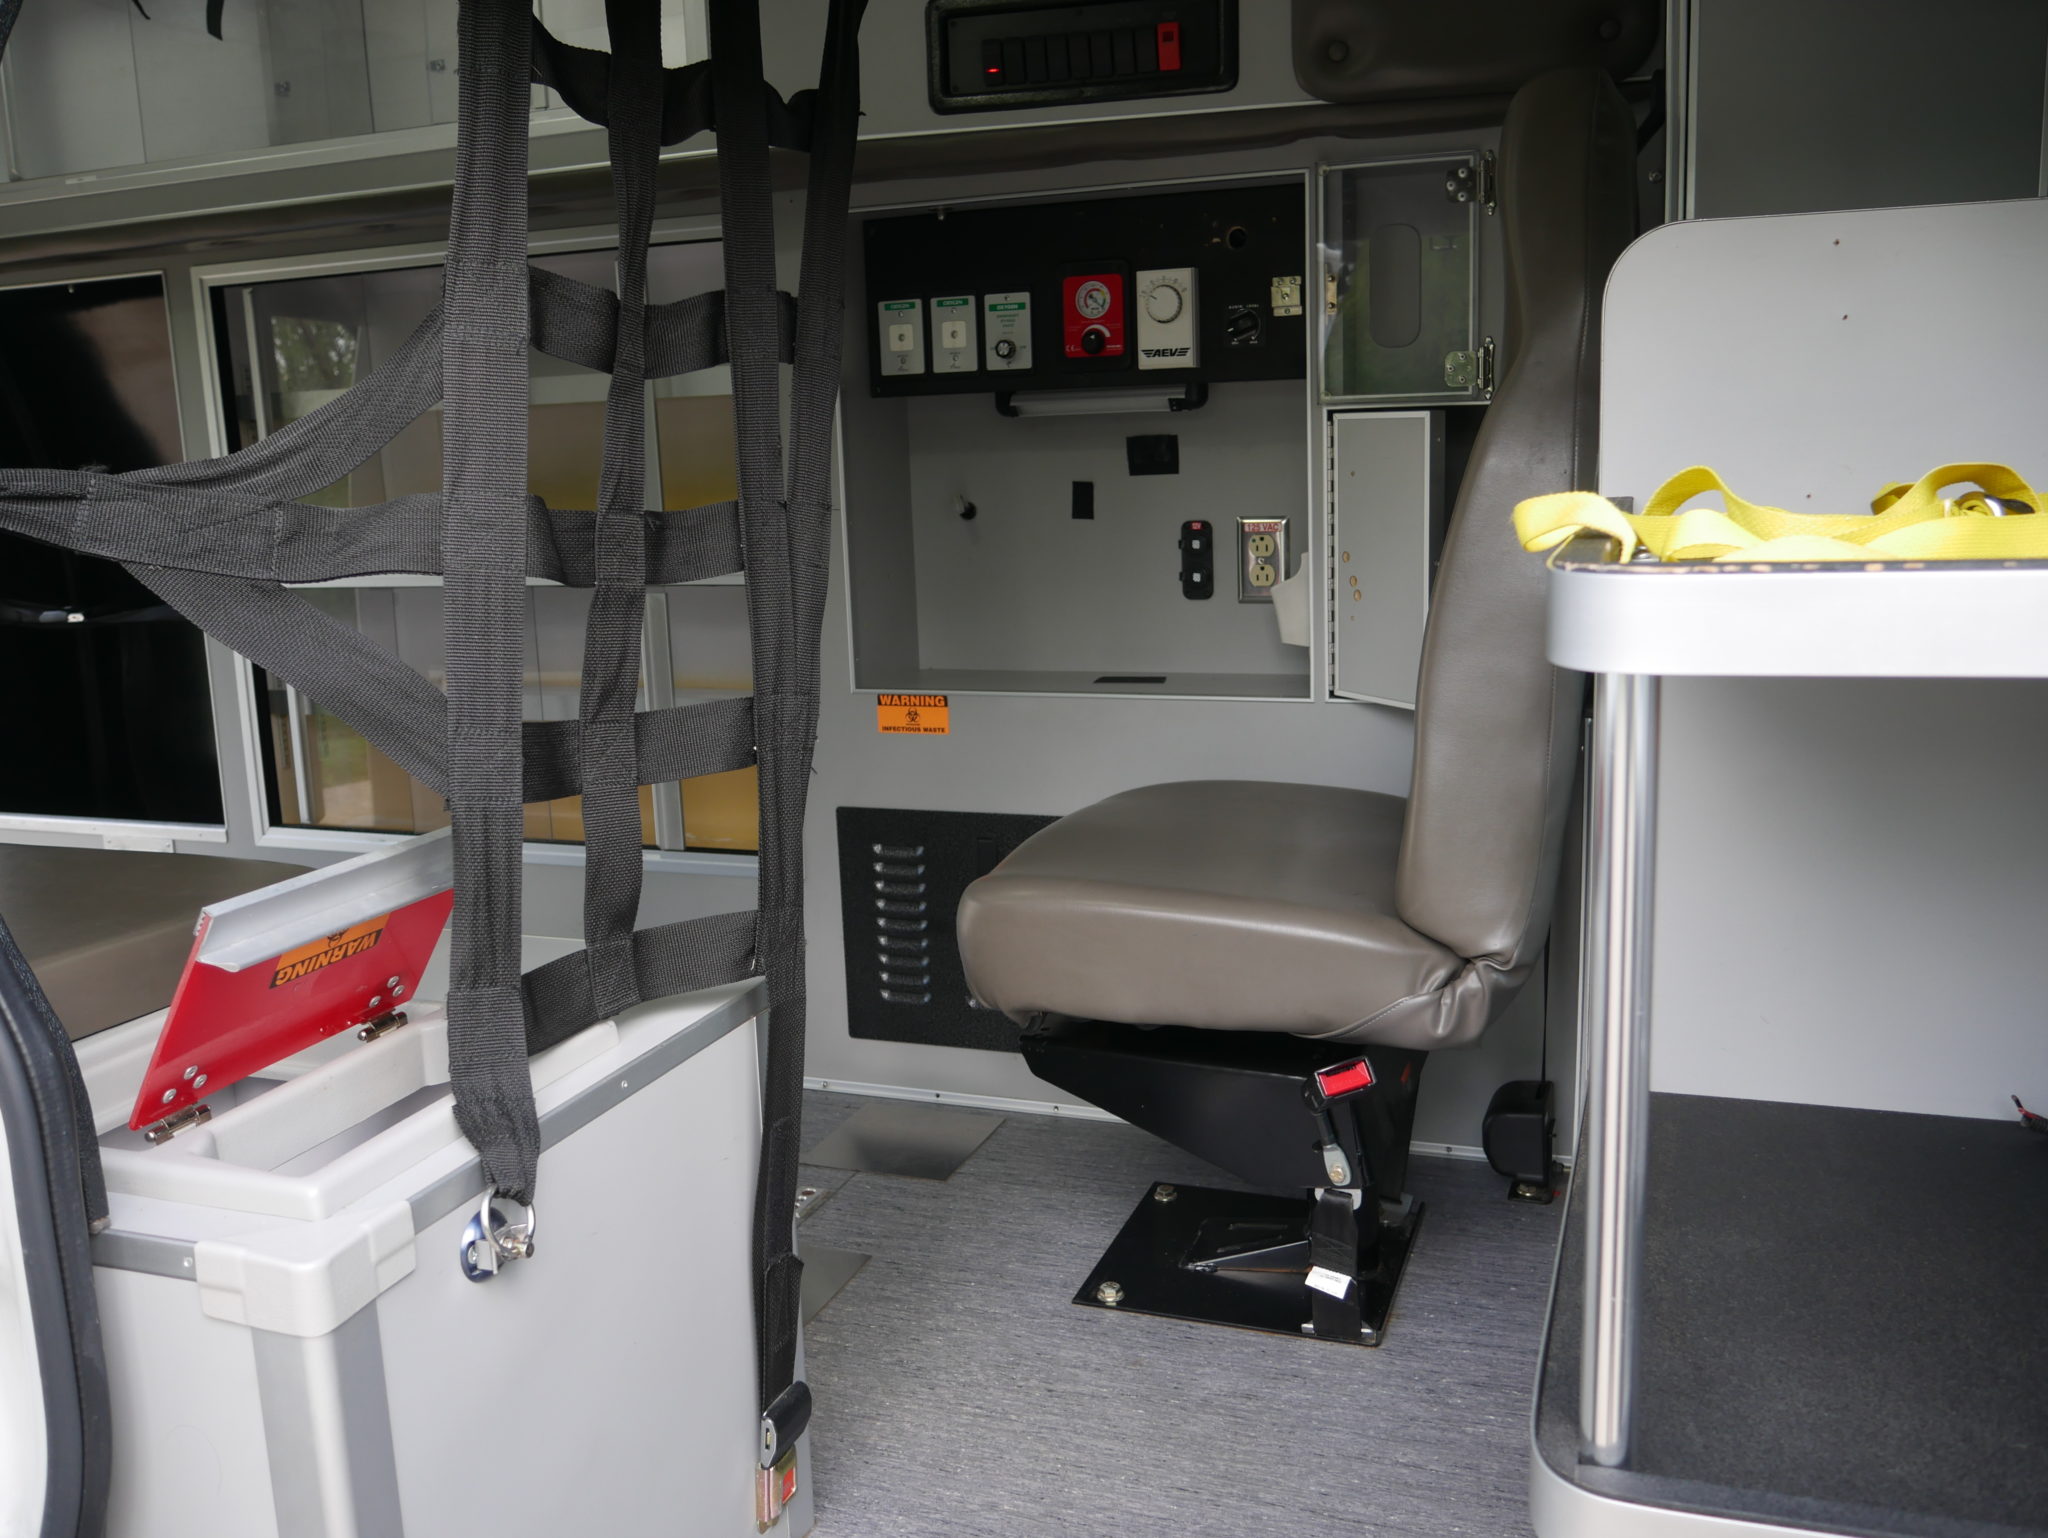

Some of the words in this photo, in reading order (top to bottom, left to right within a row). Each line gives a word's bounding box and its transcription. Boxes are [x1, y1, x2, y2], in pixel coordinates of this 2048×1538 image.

[1262, 523, 1279, 531] VAC
[879, 695, 945, 707] WARNING
[275, 932, 377, 986] WARNING
